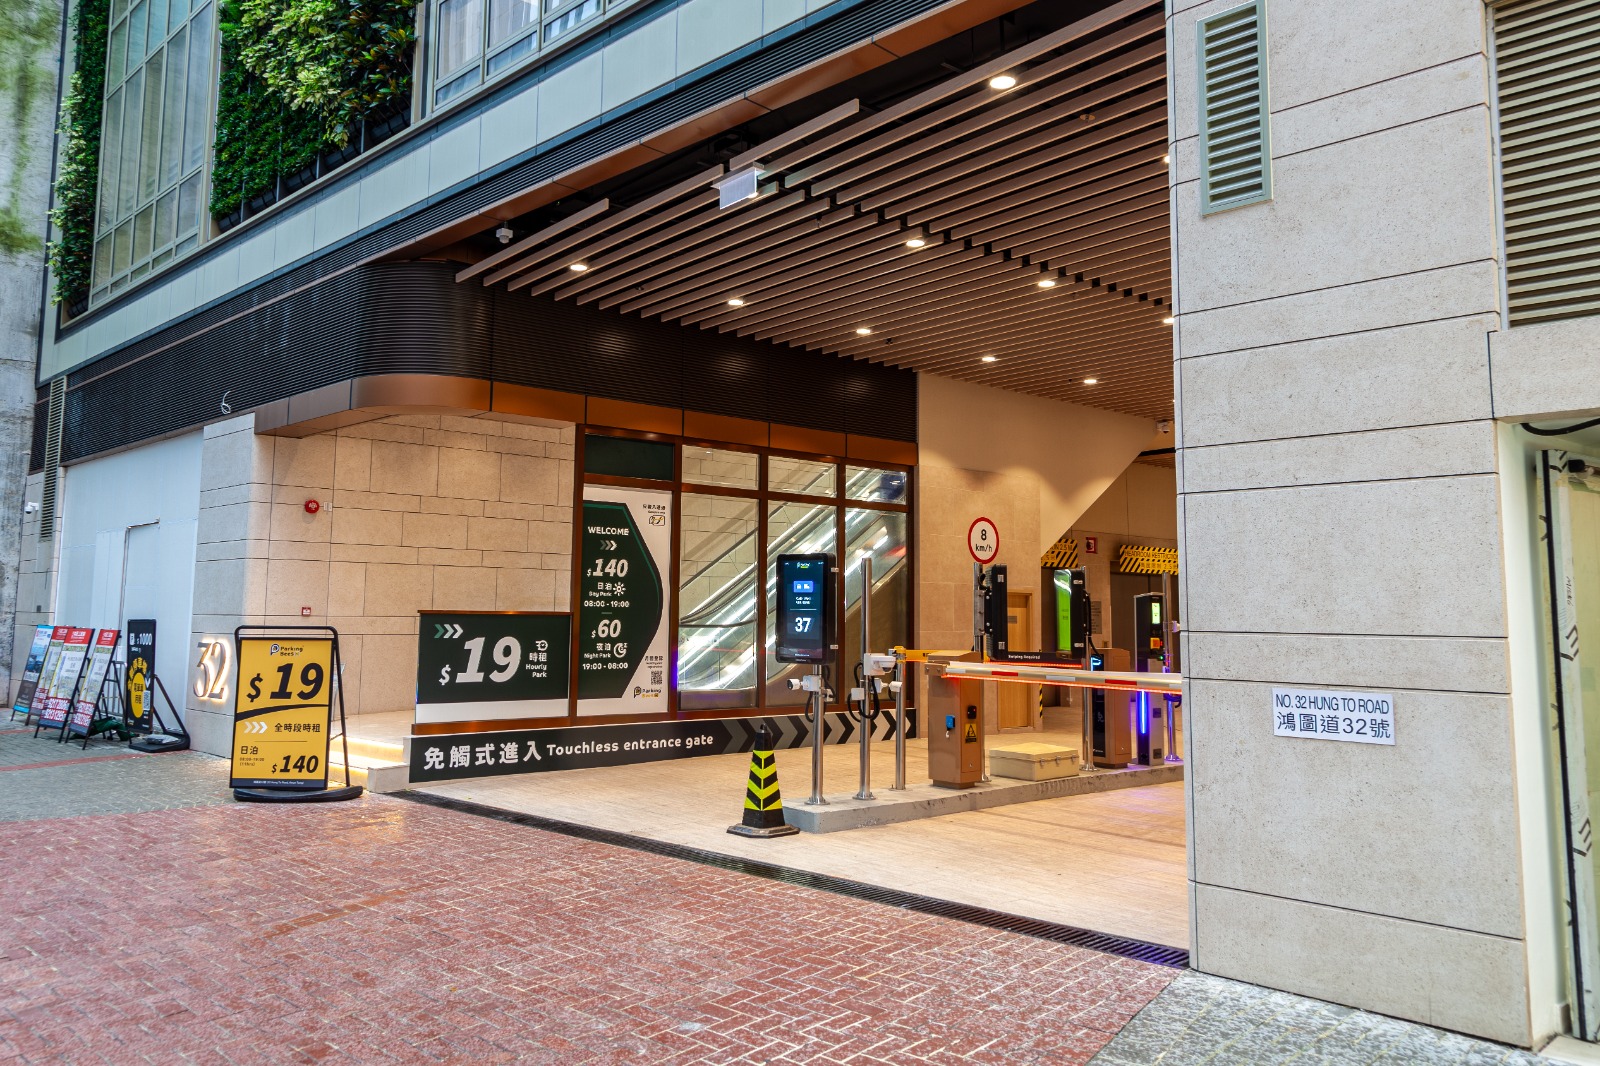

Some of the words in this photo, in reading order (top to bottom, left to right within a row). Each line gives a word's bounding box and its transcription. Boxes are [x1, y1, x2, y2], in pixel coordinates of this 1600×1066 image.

[587, 526, 630, 536] WELCOME
[981, 529, 987, 541] 8
[976, 544, 992, 552] km/h
[586, 558, 629, 577] $140
[597, 582, 612, 590] 日泊
[591, 619, 622, 638] $60
[794, 616, 811, 632] 37
[596, 643, 611, 651] 夜泊
[438, 636, 522, 686] $19
[529, 652, 547, 662] 時租
[193, 641, 226, 699] 32
[1276, 694, 1293, 708] NO.
[1295, 695, 1307, 709] 32
[1309, 696, 1339, 711] HUNG
[1340, 698, 1356, 712] TO
[1358, 699, 1389, 714] ROAD
[274, 723, 320, 733] 全時段時租
[1277, 712, 1390, 738] 鴻圖道32號
[240, 746, 258, 755] 日泊
[546, 740, 619, 756] Touchless
[624, 737, 682, 751] entrance
[686, 734, 713, 749] gate
[423, 740, 542, 770] 免觸式進入
[272, 755, 319, 774] $140
